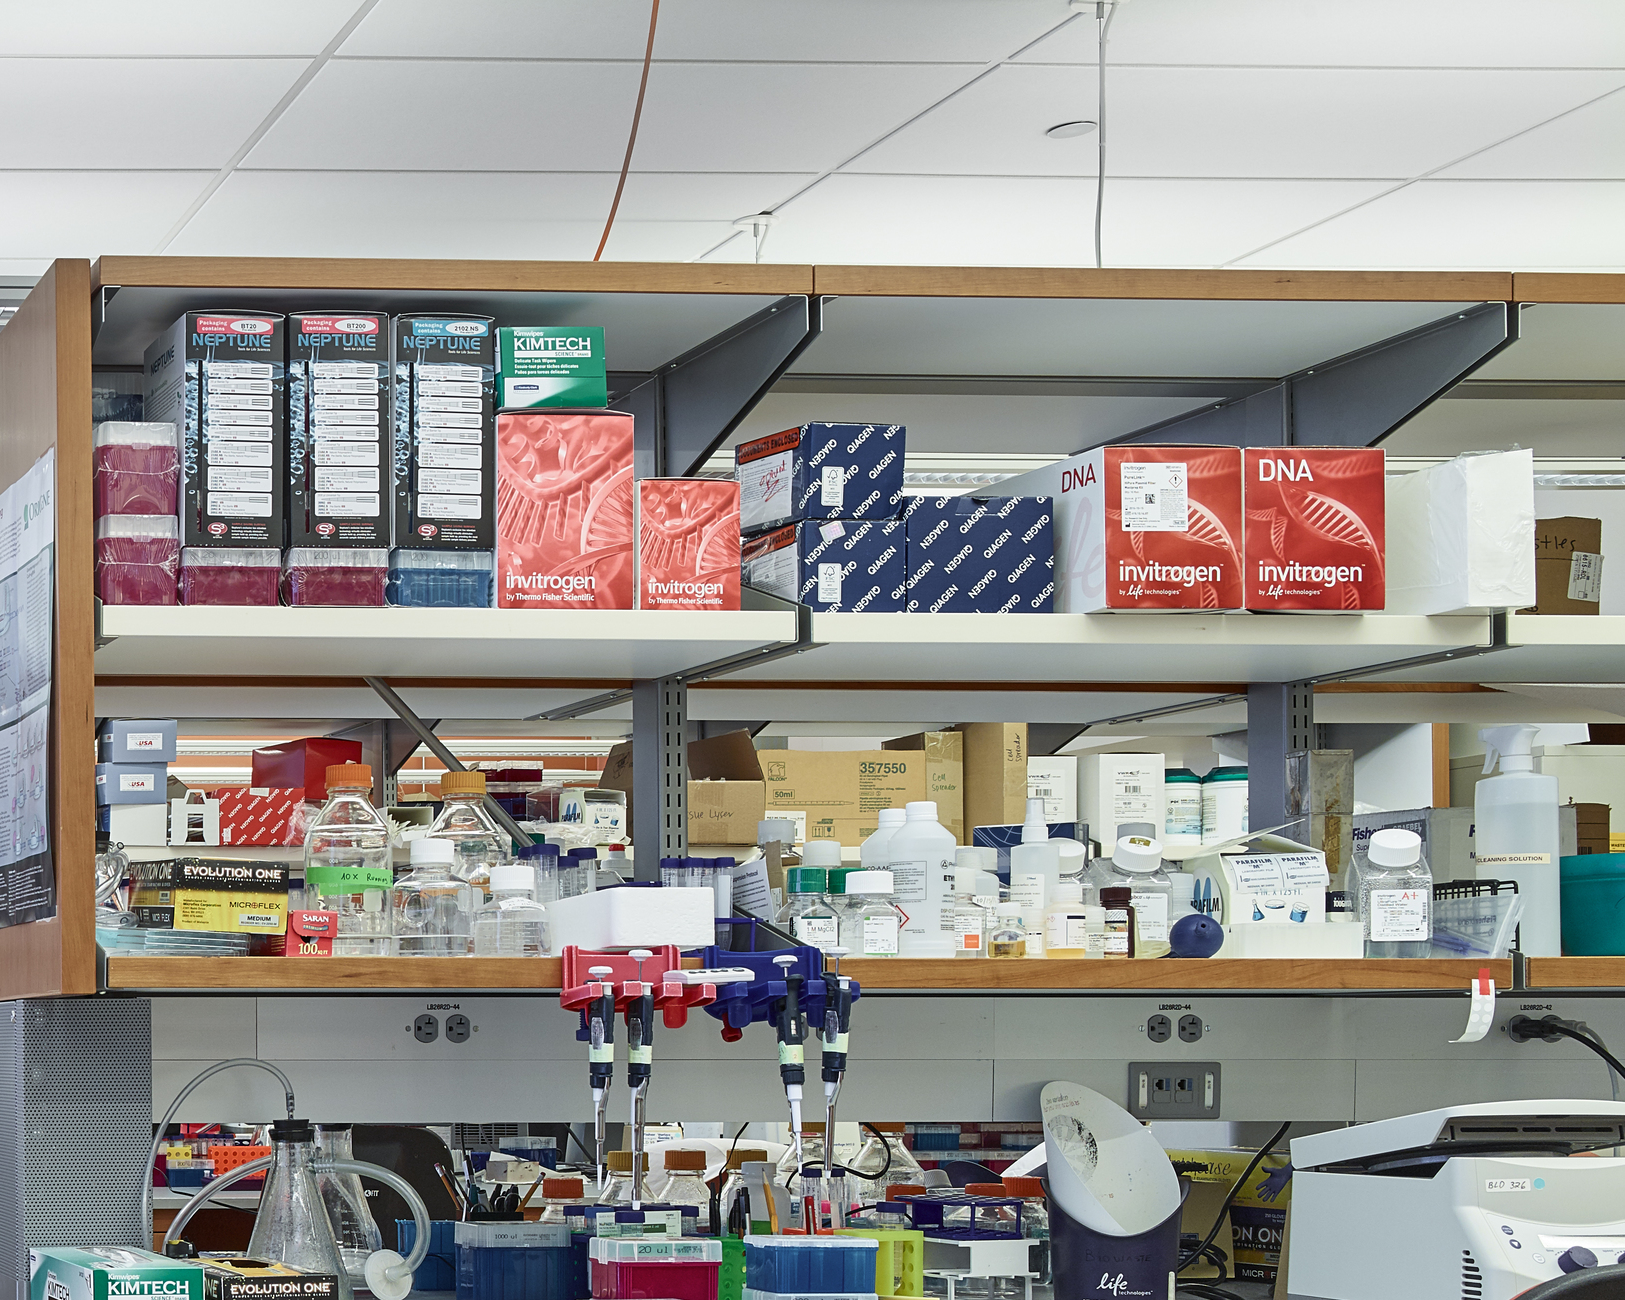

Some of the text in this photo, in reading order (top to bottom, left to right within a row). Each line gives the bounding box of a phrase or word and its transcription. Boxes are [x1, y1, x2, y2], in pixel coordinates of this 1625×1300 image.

[193, 335, 270, 347] NEPTUNE
[298, 334, 376, 347] NEPTUNE
[403, 336, 480, 350] NEPTUNE
[514, 338, 590, 350] KIMTECH
[150, 345, 175, 376] NEPTUNE
[847, 425, 874, 454] QIAGEN
[808, 439, 837, 468] QIAGEN
[869, 450, 896, 479] QIAGEN
[1259, 460, 1313, 482] DNA
[1062, 463, 1096, 493] DNA
[852, 490, 880, 519] QIAGEN
[1120, 561, 1220, 587] invitrogen
[1259, 561, 1362, 587] invitrogen
[506, 573, 595, 592] invitrogen
[649, 580, 723, 597] invitrogen
[516, 593, 541, 601] Thermo
[1127, 585, 1143, 599] life
[1266, 585, 1283, 599] life
[860, 763, 906, 774] 357550
[933, 773, 946, 781] Cell
[775, 790, 793, 798] 50ml
[932, 783, 957, 792] Spreader
[184, 865, 281, 879] EVOLUTION ONE
[367, 873, 387, 883] Running
[1402, 892, 1419, 900] A+
[303, 914, 329, 922] SARAN
[299, 943, 318, 955] 100
[1510, 1181, 1526, 1189] 326
[638, 1246, 652, 1254] 20
[108, 1281, 189, 1295] KIMTECH
[230, 1282, 331, 1295] EVOLUTION ONE
[1096, 1273, 1128, 1296] life
